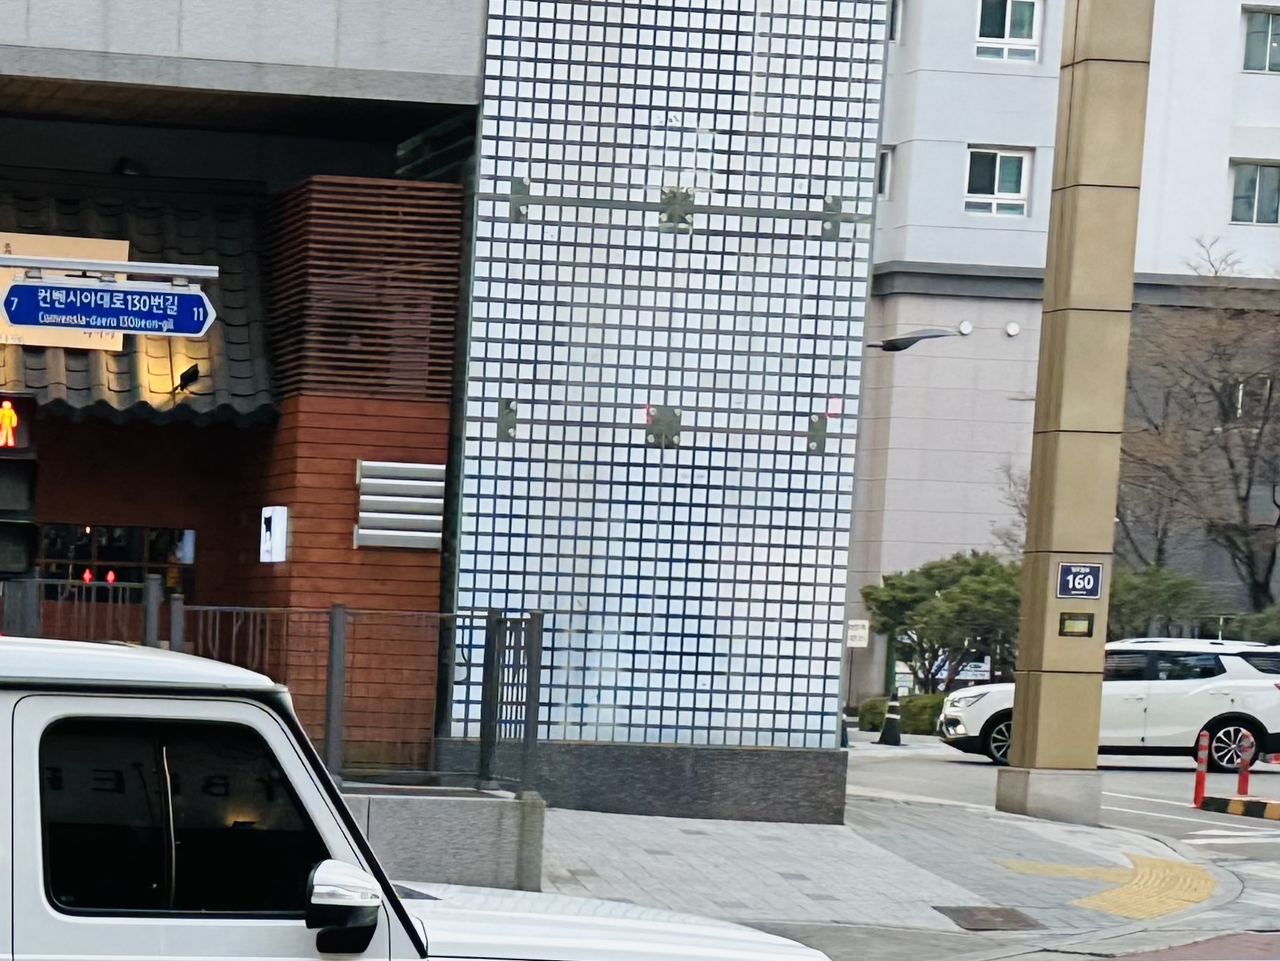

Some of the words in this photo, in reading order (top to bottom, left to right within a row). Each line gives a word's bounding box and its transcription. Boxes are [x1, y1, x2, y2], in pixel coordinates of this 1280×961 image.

[10, 297, 18, 311] 7
[38, 288, 178, 316] 컨벤시아대로130번길
[193, 307, 204, 321] 11
[1066, 574, 1094, 590] 160
